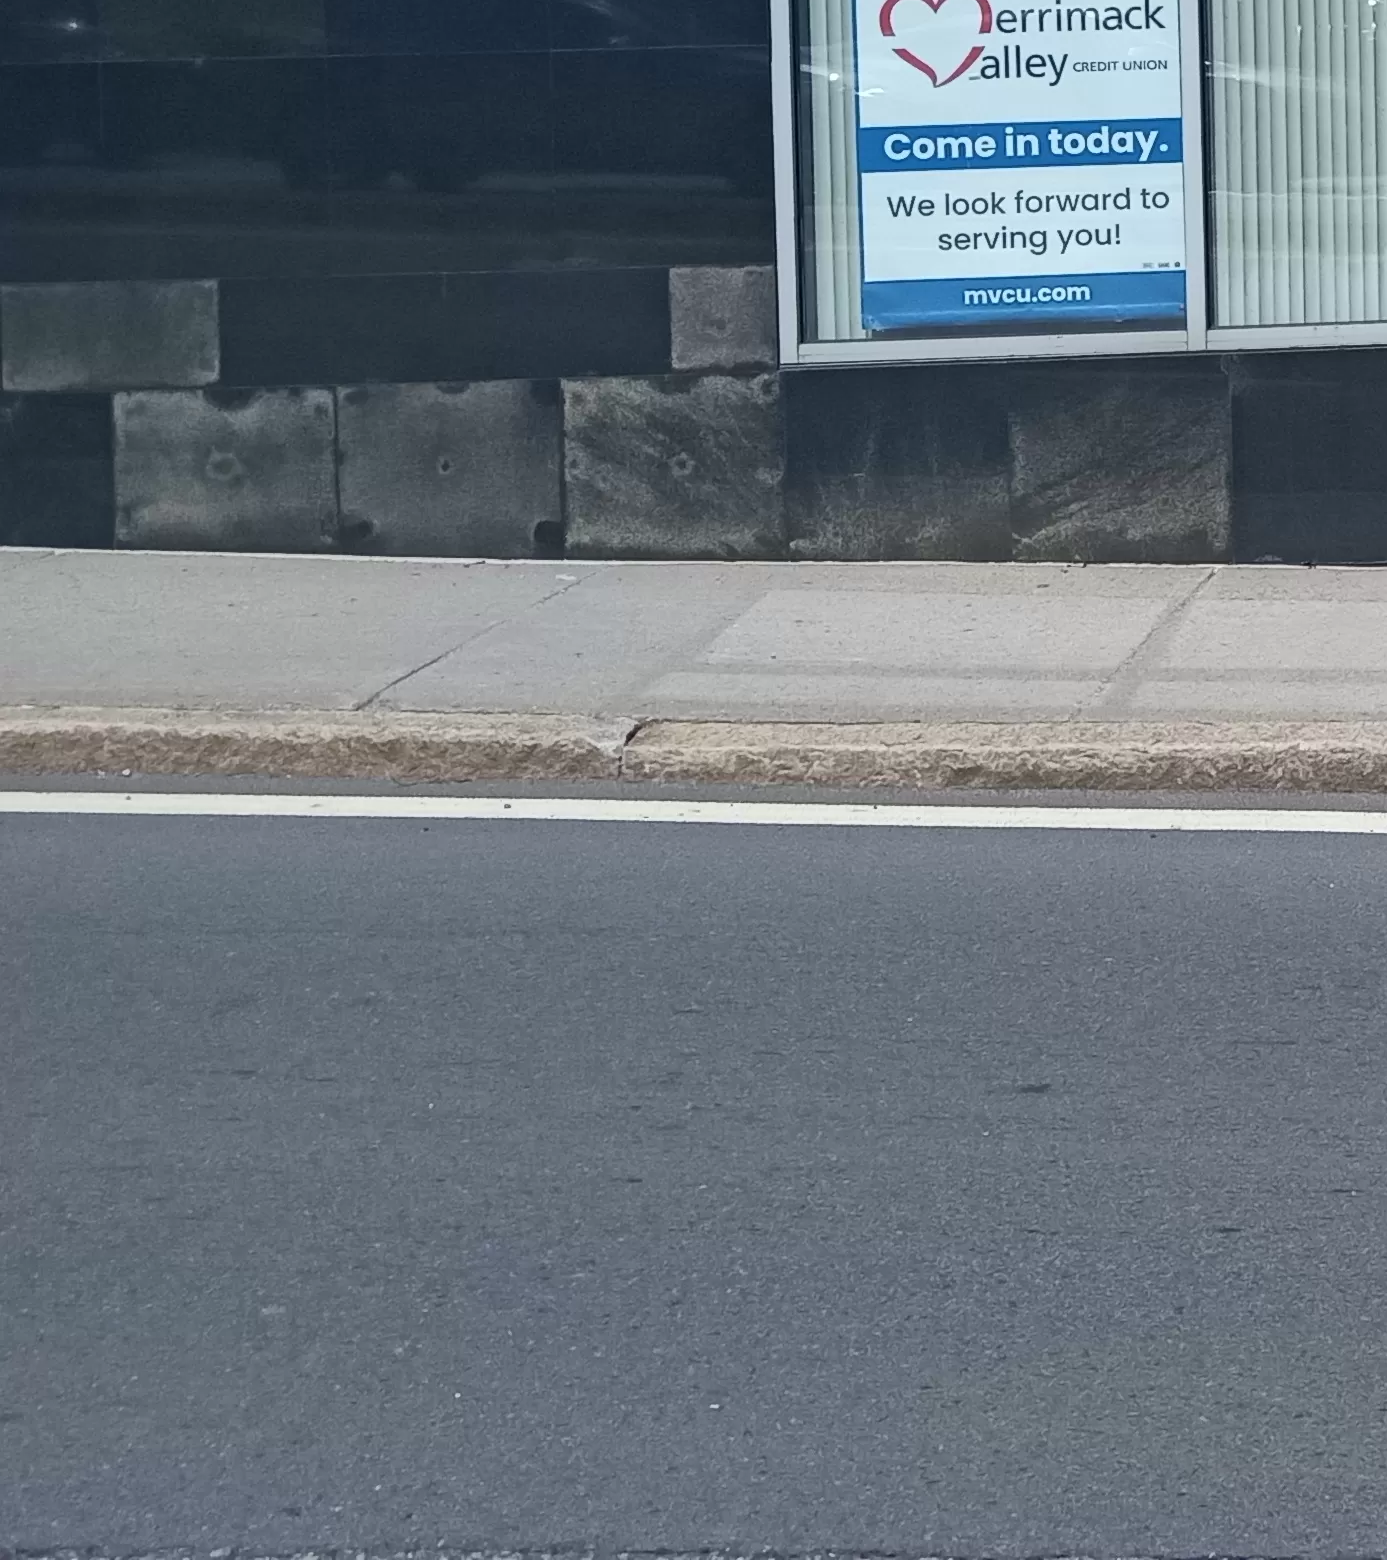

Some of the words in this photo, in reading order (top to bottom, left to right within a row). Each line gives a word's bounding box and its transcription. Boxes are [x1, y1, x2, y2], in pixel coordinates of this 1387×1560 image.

[1073, 60, 1118, 73] CREDIT
[1122, 59, 1168, 72] UNION
[884, 132, 996, 161] Come
[1005, 127, 1039, 157] in
[1049, 125, 1169, 162] today.
[886, 194, 935, 217] We
[945, 192, 1006, 216] look
[1015, 188, 1131, 213] forward
[1140, 189, 1170, 209] to
[938, 224, 1047, 256] serving
[1057, 223, 1122, 253] you!
[964, 282, 1091, 305] mvcu.com
